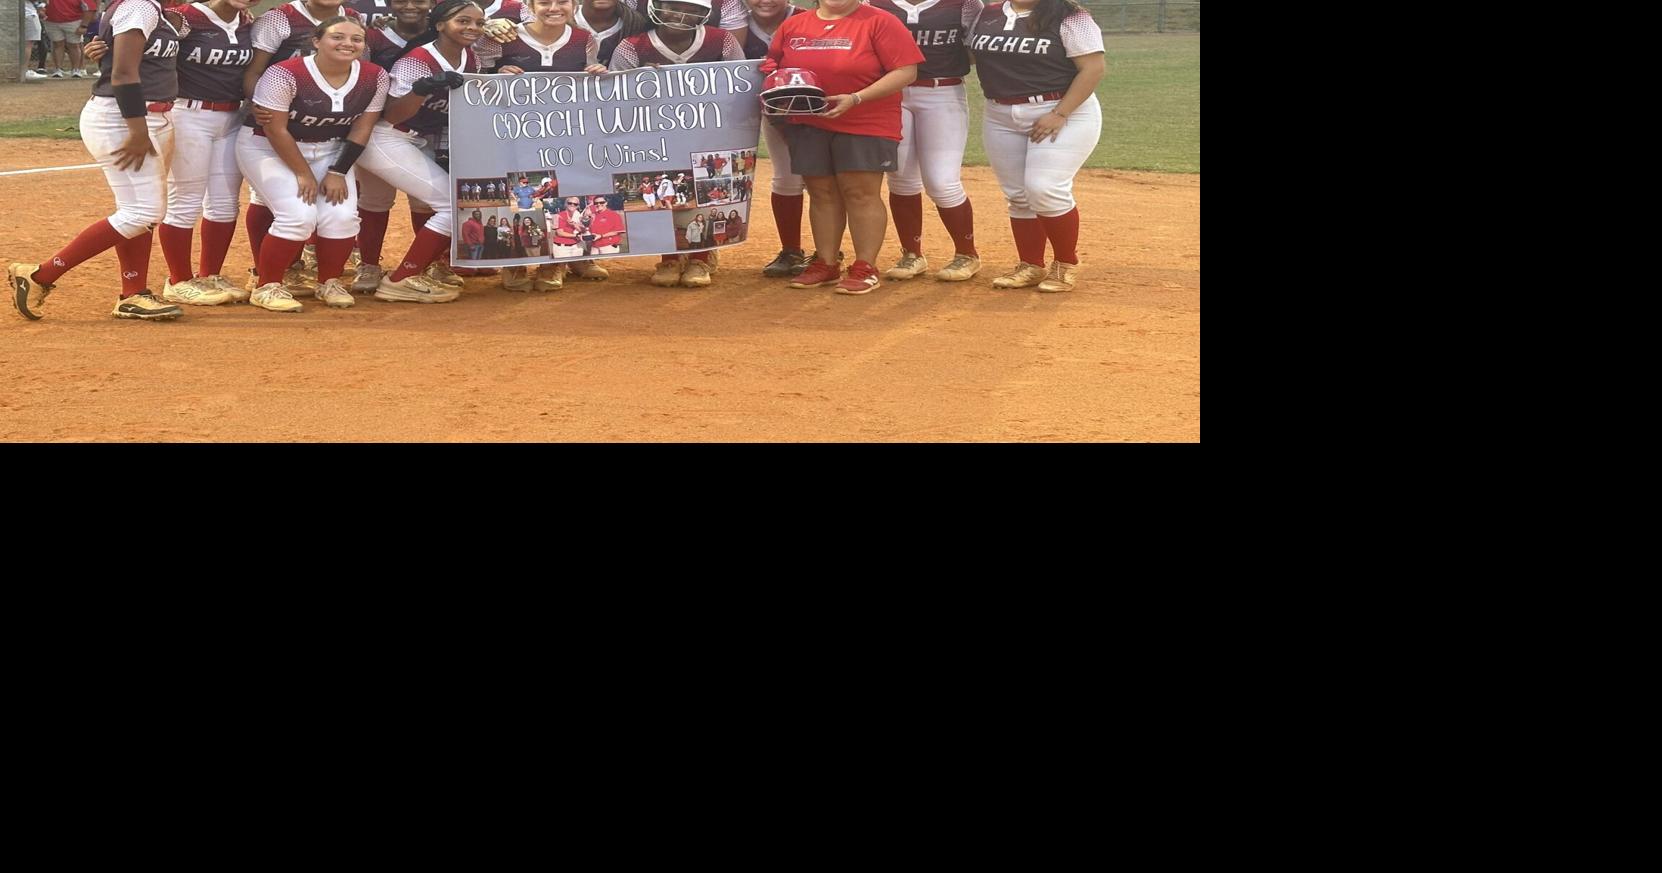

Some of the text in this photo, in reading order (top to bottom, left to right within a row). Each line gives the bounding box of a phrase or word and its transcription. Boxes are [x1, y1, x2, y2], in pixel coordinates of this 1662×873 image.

[910, 29, 958, 46] HER
[971, 34, 1051, 55] RCHER
[186, 46, 253, 65] ARCH
[789, 73, 806, 85] A
[493, 101, 722, 140] COACH WILSON
[539, 138, 669, 170] 100 Wins!
